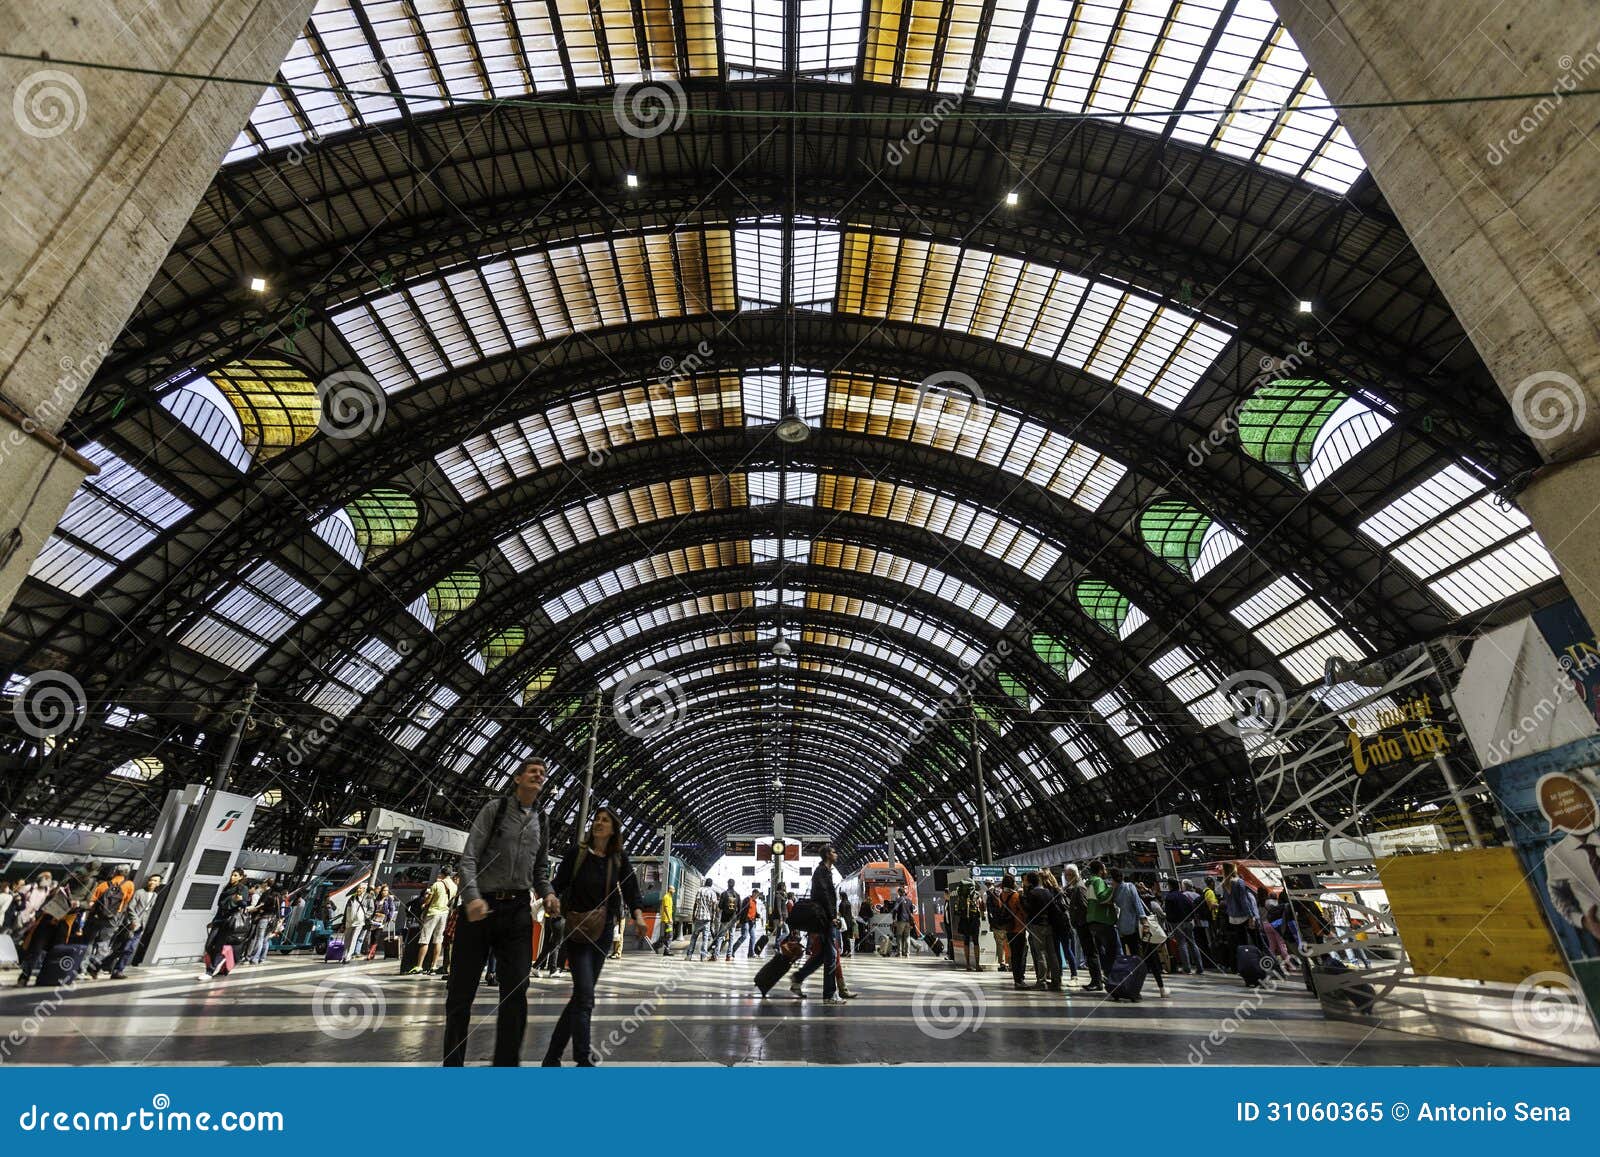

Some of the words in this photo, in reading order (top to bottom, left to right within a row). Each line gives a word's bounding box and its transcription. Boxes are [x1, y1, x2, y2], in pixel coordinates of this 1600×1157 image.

[1376, 693, 1433, 730] tourist
[1402, 725, 1450, 757] box
[384, 866, 393, 874] 11
[921, 869, 931, 877] 13
[1159, 872, 1168, 880] 14
